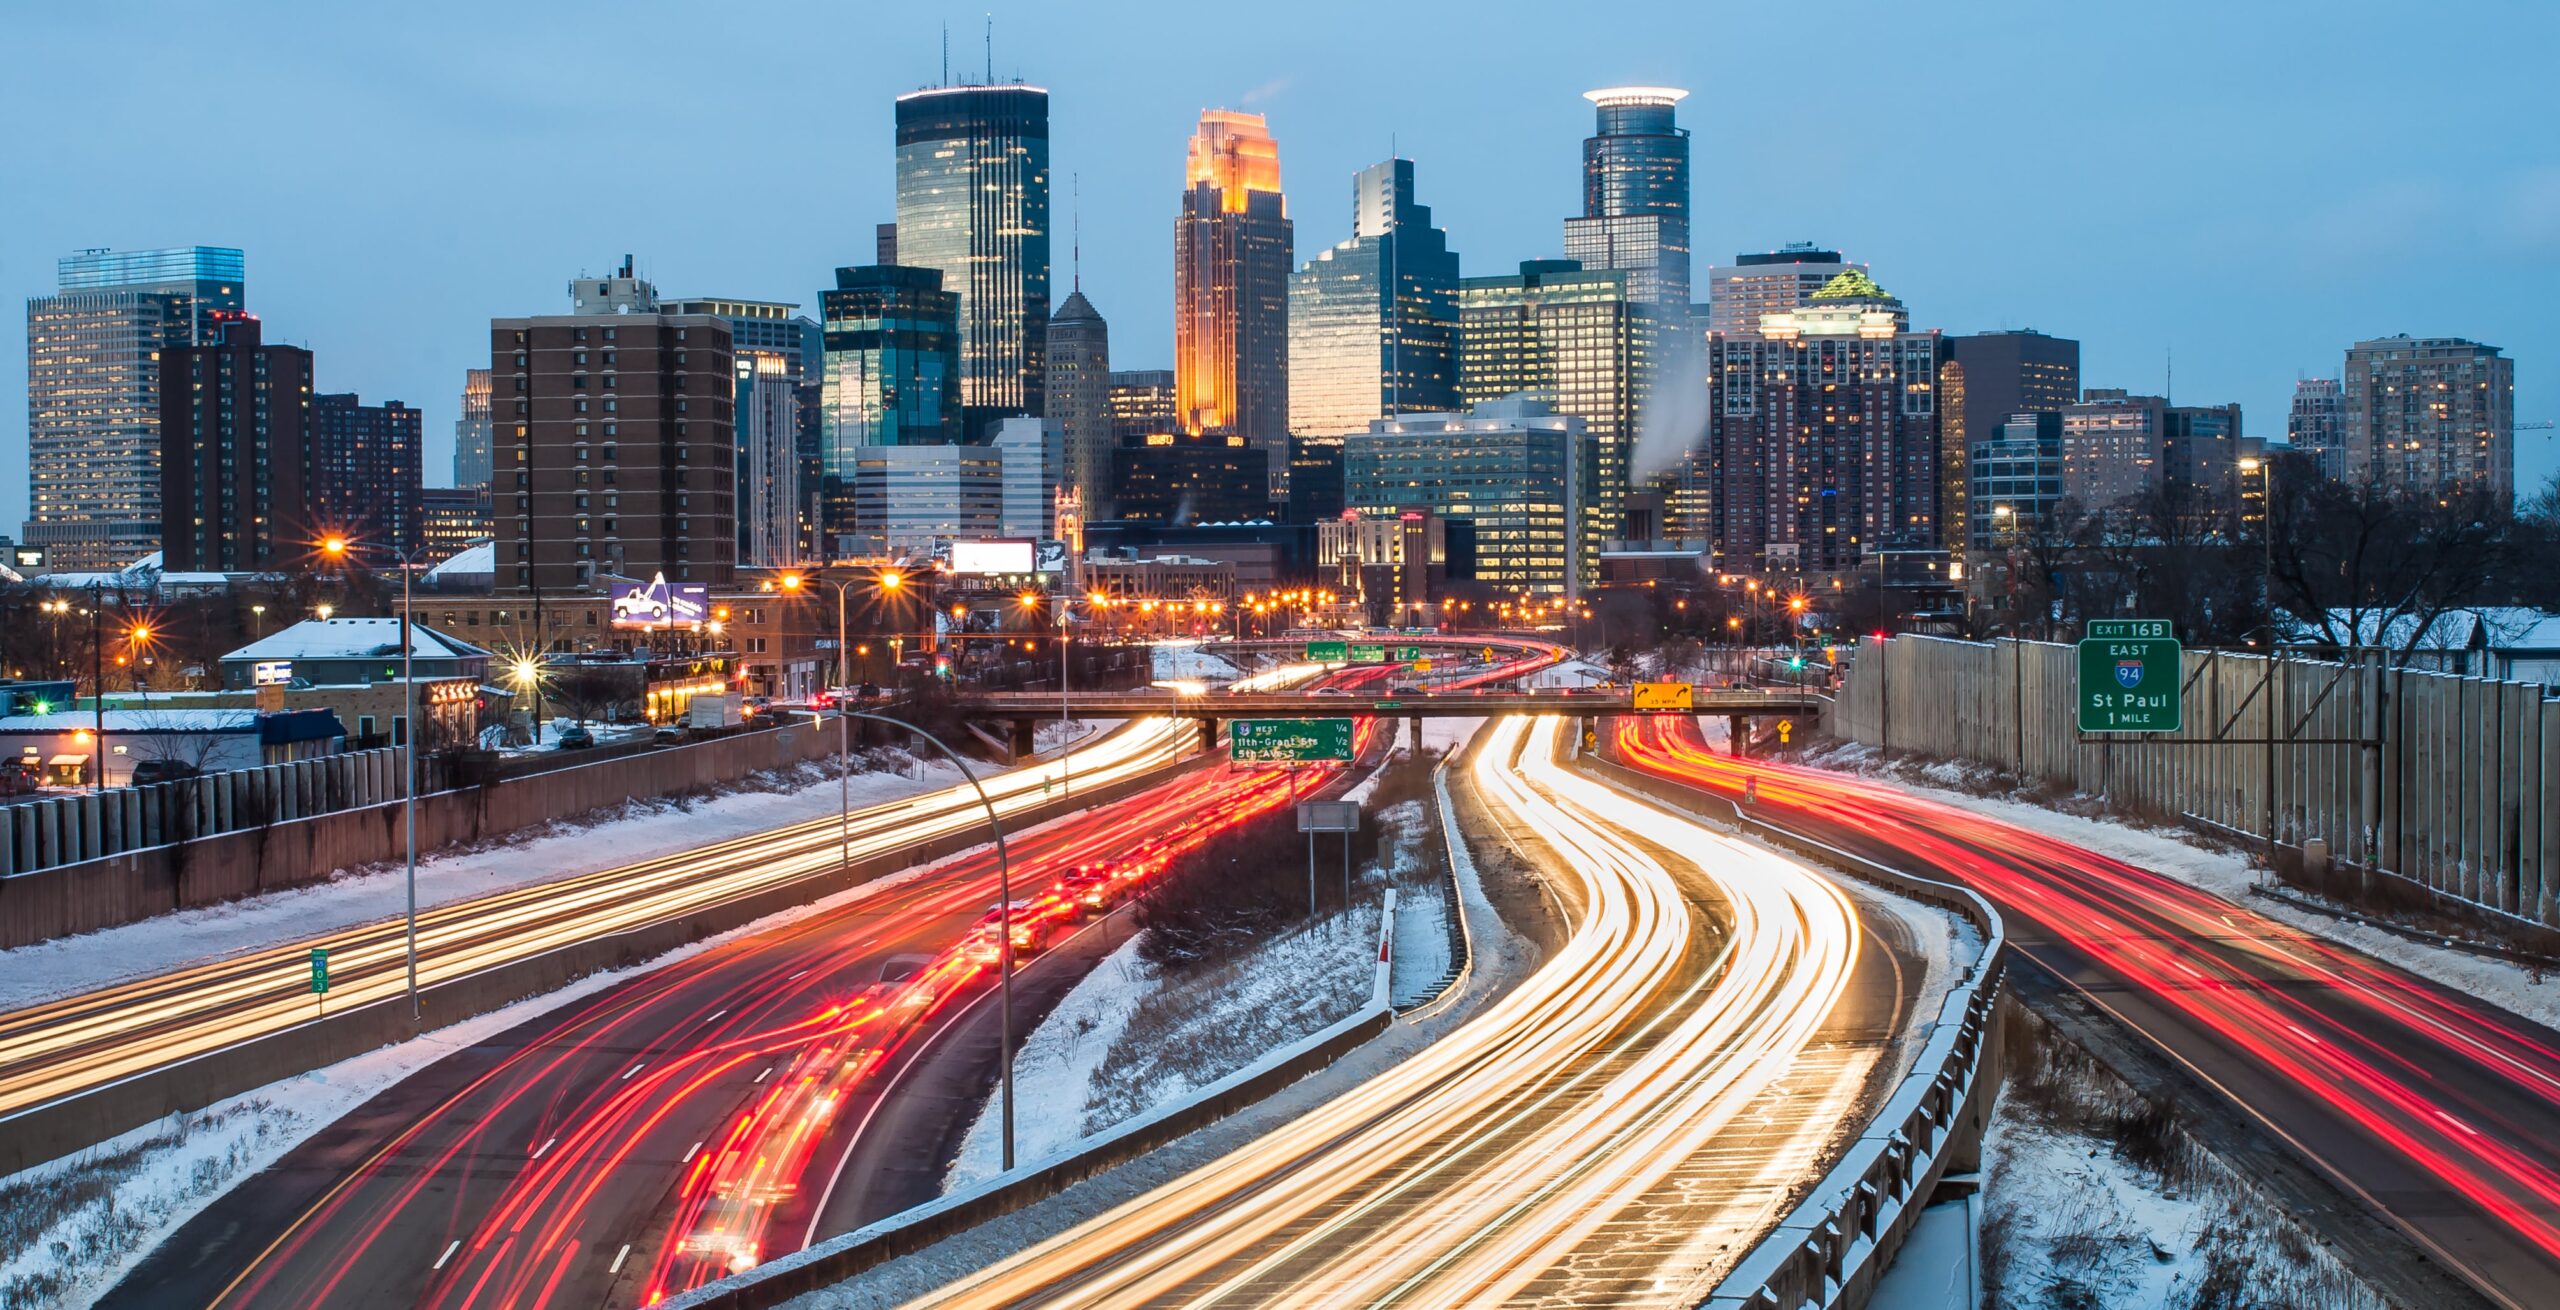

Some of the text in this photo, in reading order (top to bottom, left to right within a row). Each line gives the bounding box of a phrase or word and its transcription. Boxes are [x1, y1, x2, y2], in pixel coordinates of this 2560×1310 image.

[2096, 624, 2163, 636] EXIT 16B
[2110, 645, 2149, 656] EAST
[2119, 667, 2140, 681] 94
[2092, 694, 2167, 707] St Paul
[2108, 712, 2151, 725] 1 MILE
[1335, 723, 1348, 733] 1/4
[1238, 737, 1348, 747] 11th-Grant Sts 1/2
[1238, 749, 1257, 758] 5th
[1334, 748, 1348, 757] 3/4
